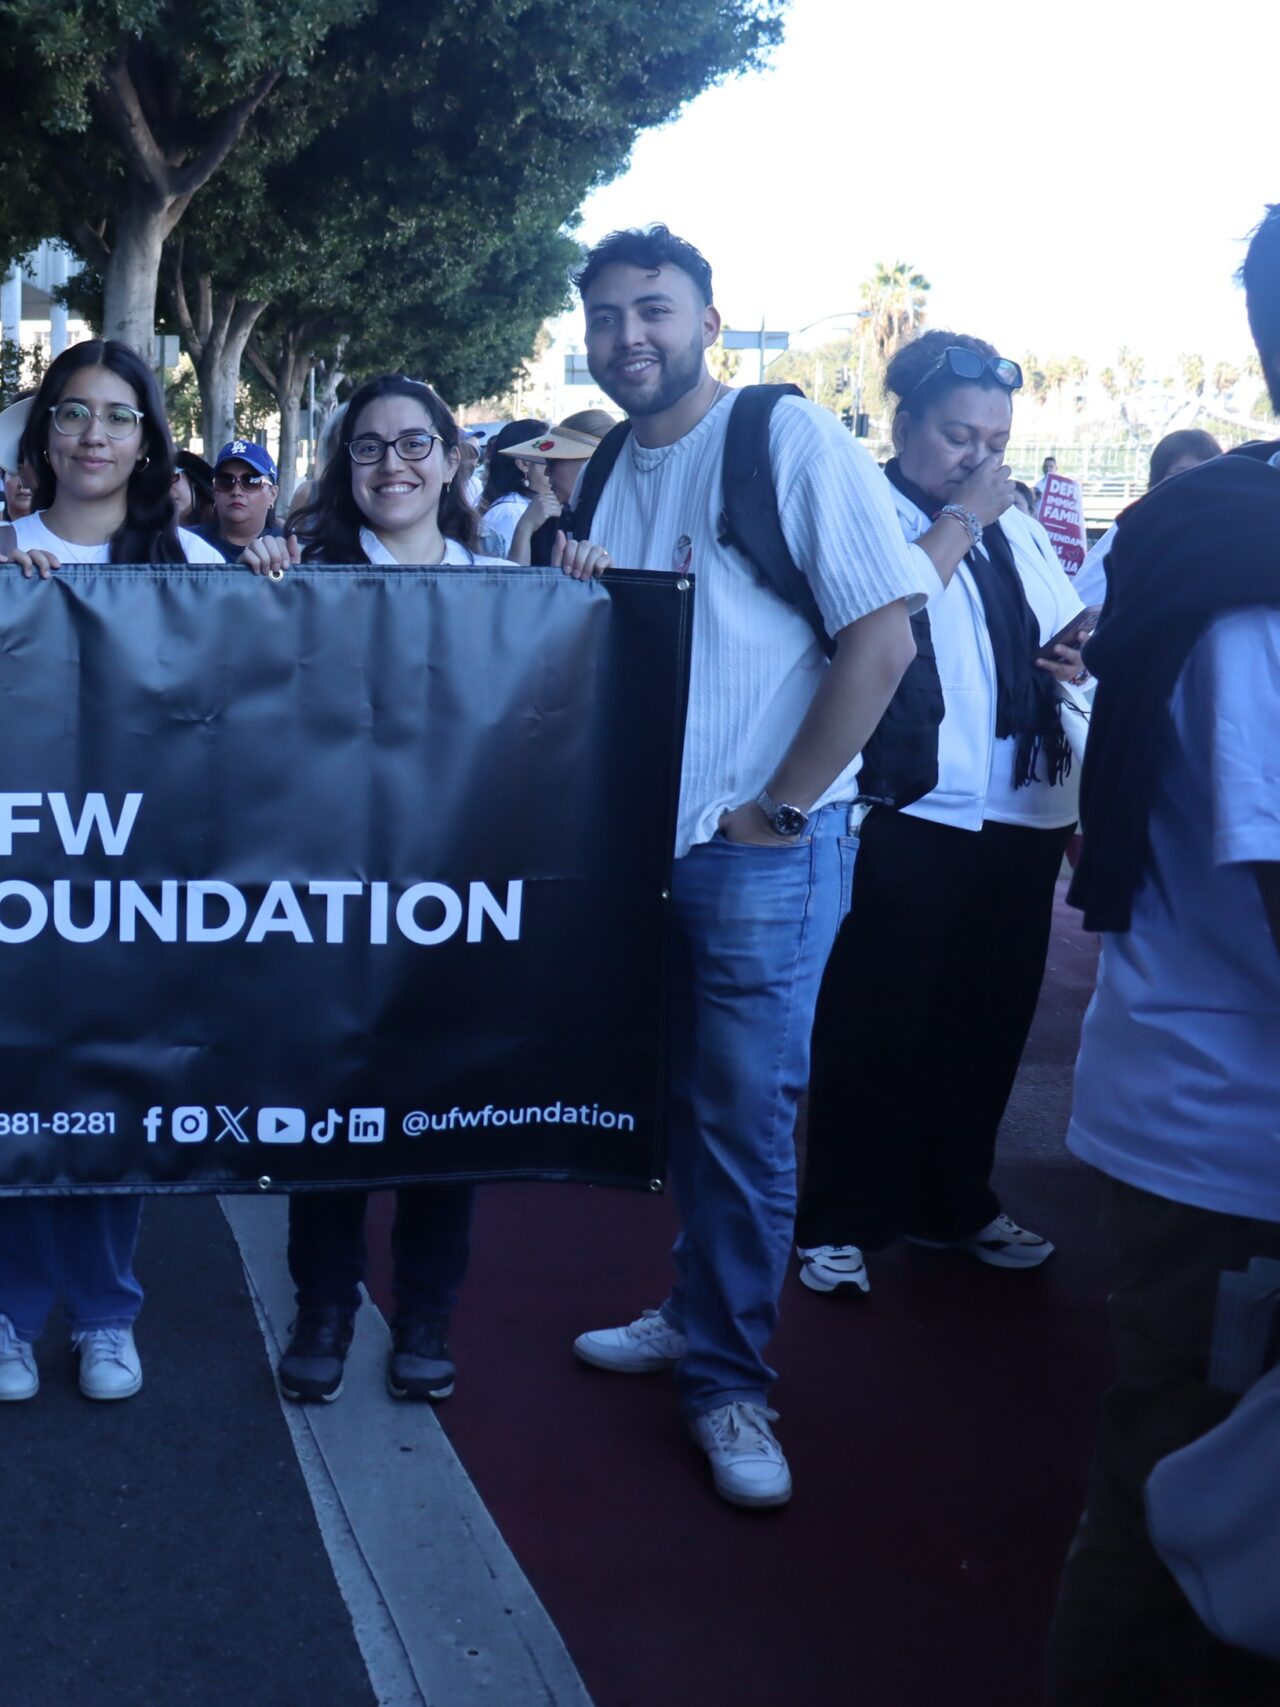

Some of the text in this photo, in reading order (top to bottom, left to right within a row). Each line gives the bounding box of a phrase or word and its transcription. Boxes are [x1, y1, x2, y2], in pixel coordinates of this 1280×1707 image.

[231, 440, 247, 454] LA
[1046, 494, 1079, 511] IMMIG
[1043, 505, 1080, 525] FAMIL
[402, 1101, 635, 1137] @ufwfoundation
